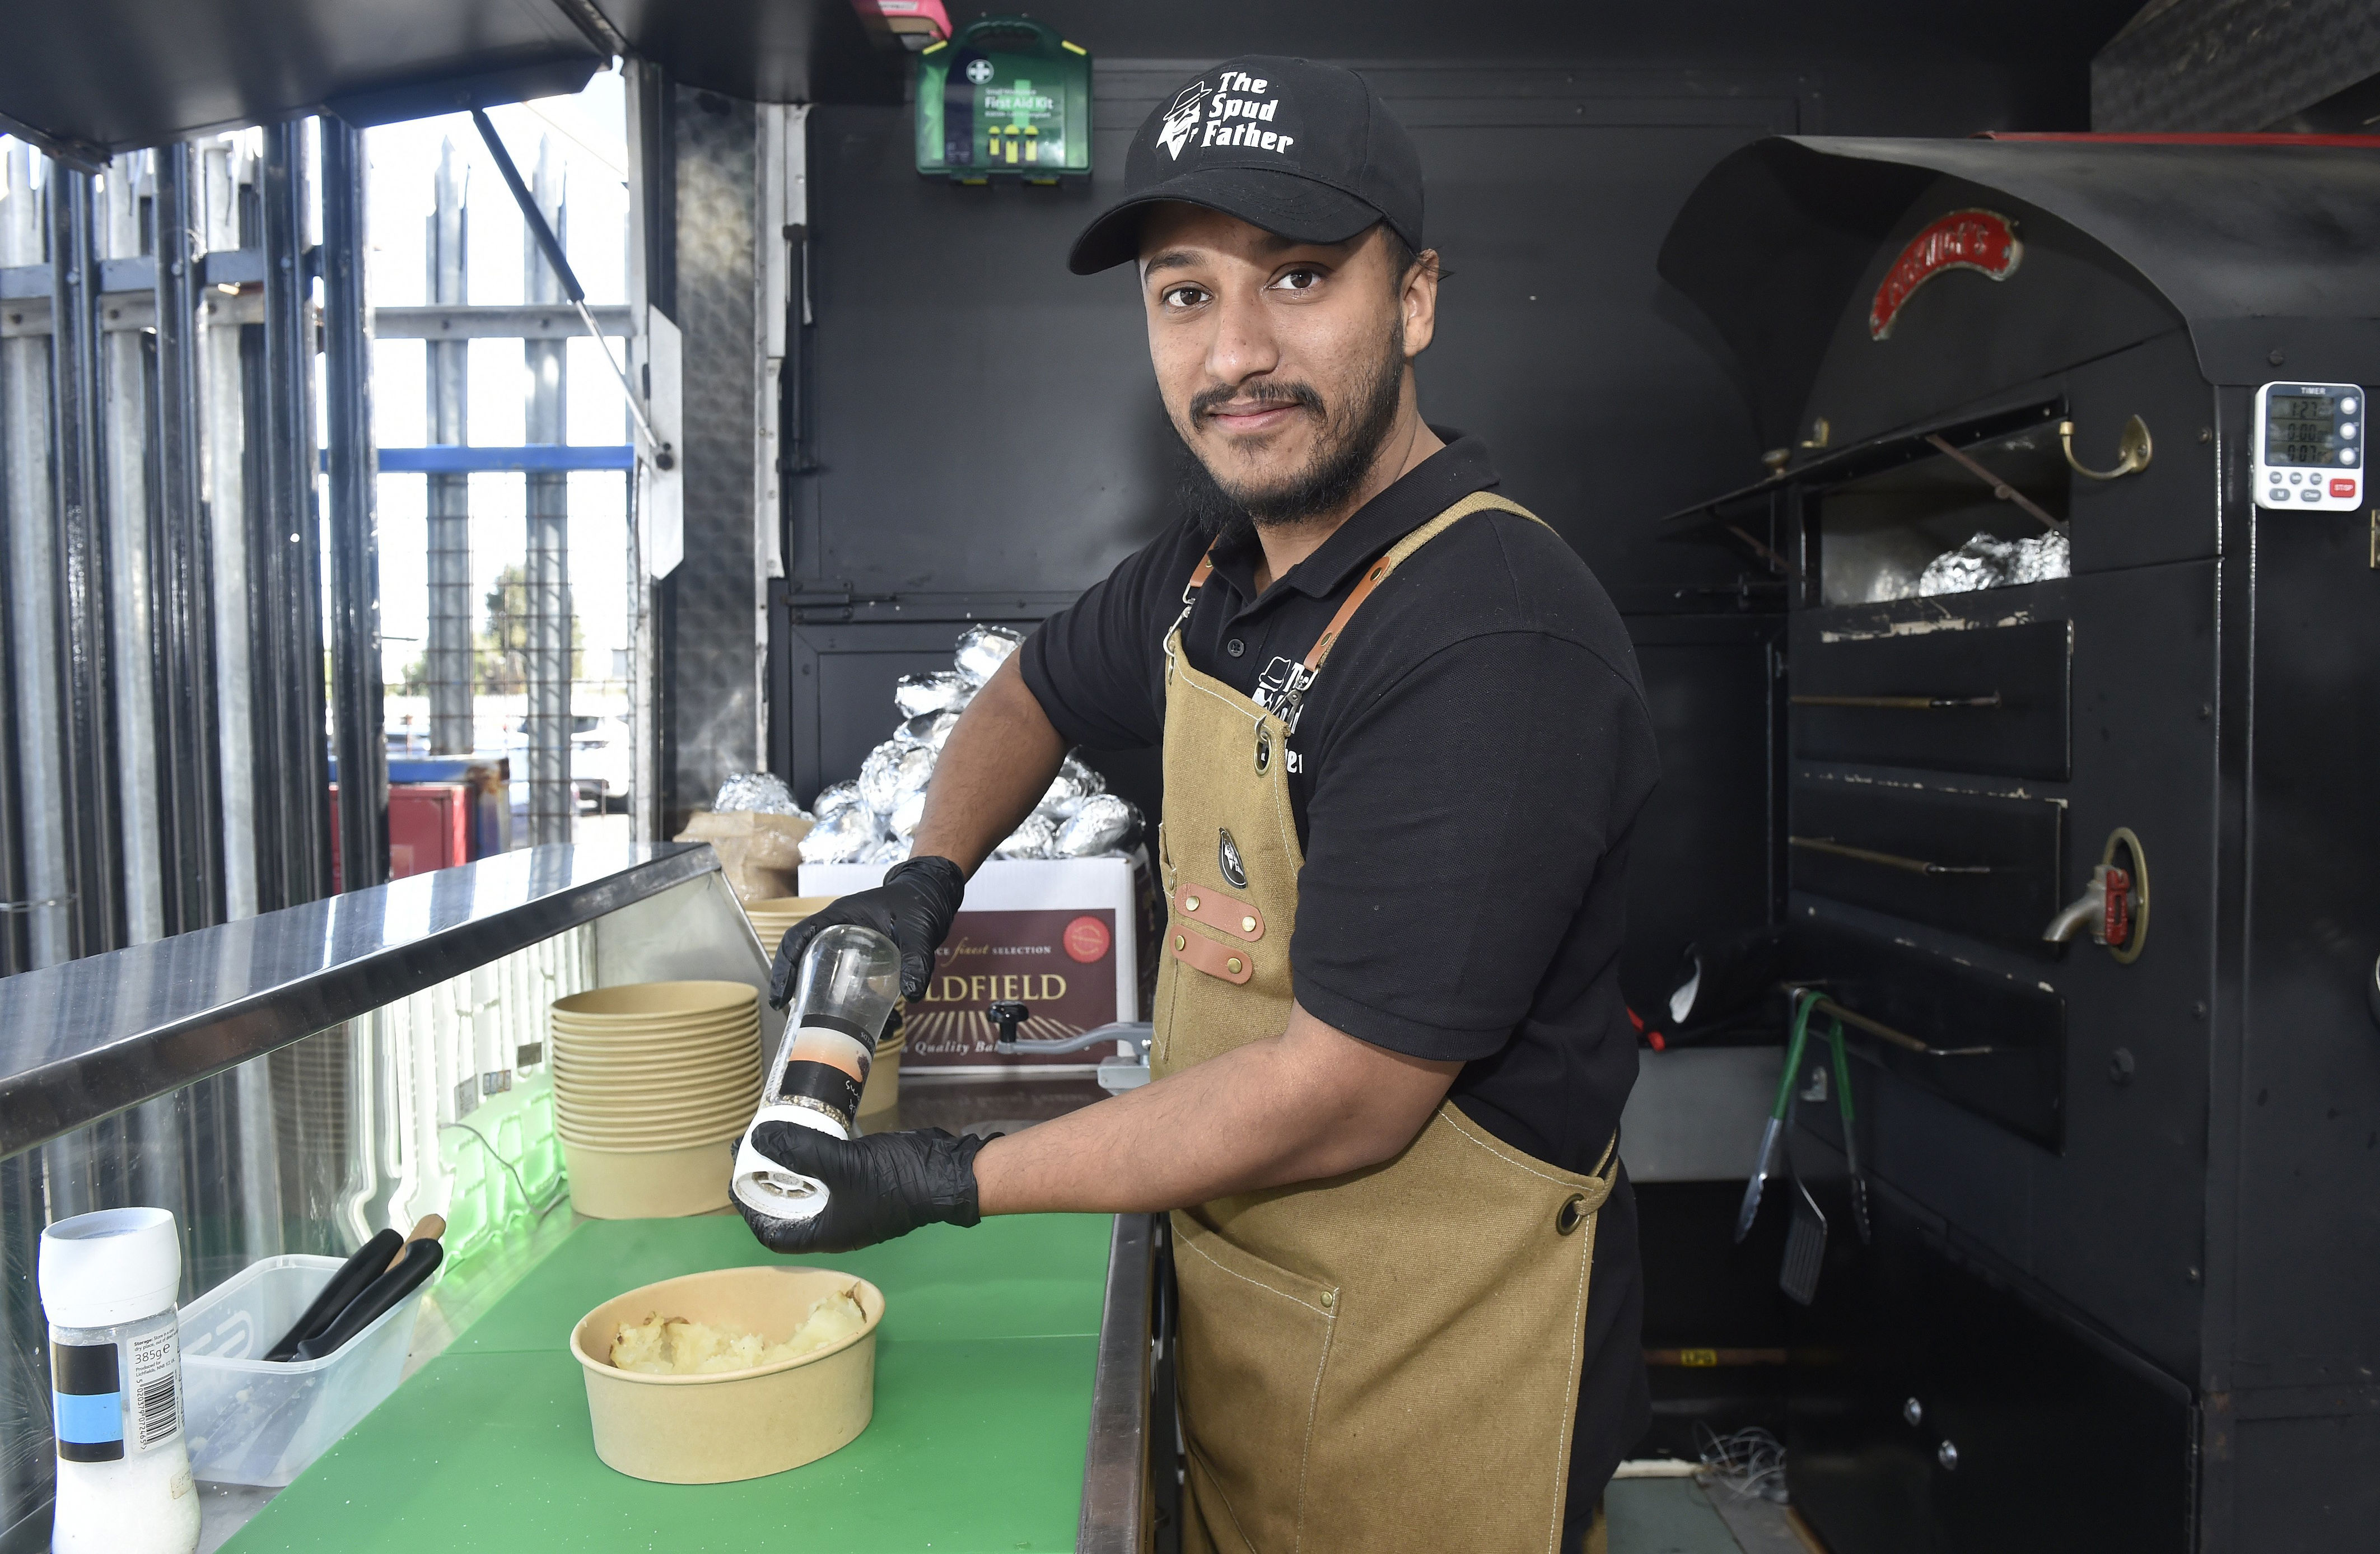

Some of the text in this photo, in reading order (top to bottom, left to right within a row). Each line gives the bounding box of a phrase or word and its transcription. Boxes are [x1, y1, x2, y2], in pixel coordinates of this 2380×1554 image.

[1217, 71, 1268, 94] The
[984, 96, 1053, 110] First Aid Kit
[1208, 92, 1278, 122] Spud
[1200, 119, 1294, 154] Father
[941, 936, 990, 967] finest
[992, 945, 1052, 955] SELECTION
[925, 973, 1067, 1002] LDFIELD
[915, 1040, 970, 1056] Quality
[134, 1338, 153, 1347] Storage:
[135, 1343, 170, 1364] 385g e
[136, 1362, 155, 1372] Produced
